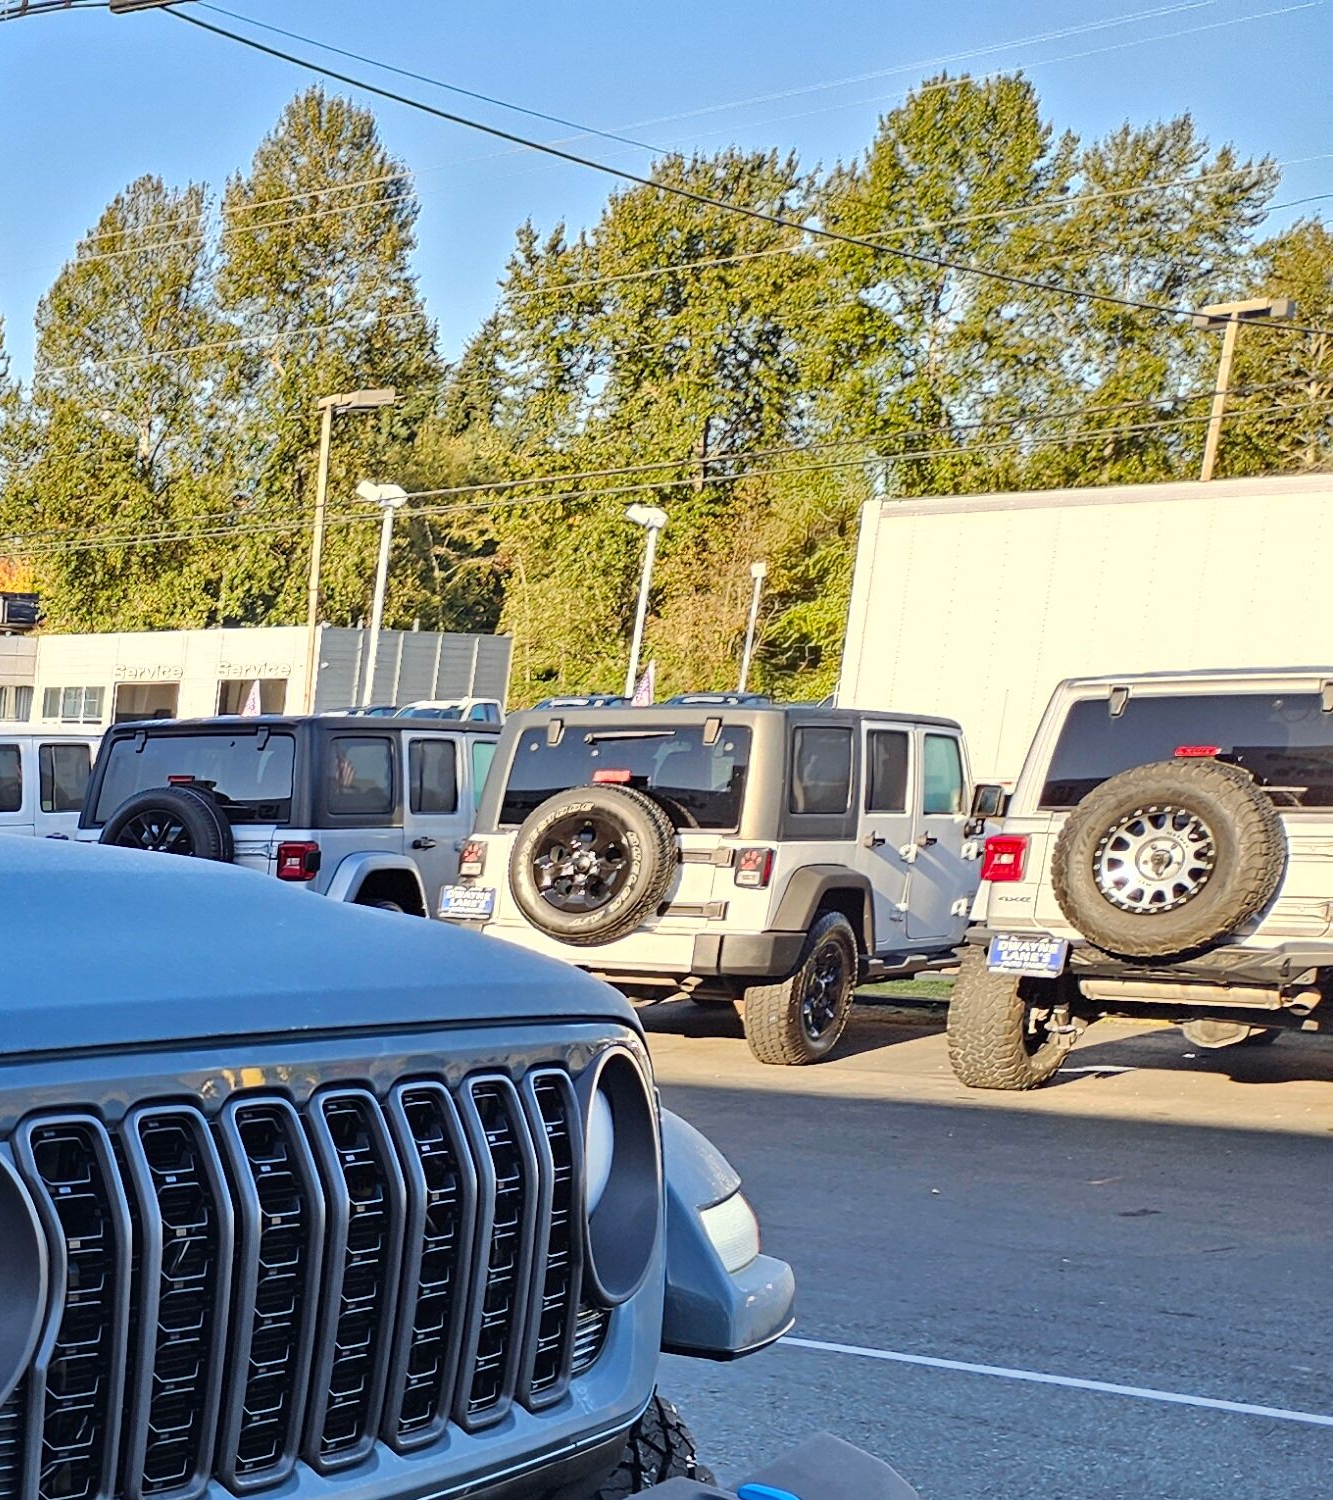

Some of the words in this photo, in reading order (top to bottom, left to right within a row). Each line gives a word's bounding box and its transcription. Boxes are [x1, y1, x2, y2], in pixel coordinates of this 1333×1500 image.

[115, 663, 183, 679] Service
[218, 660, 291, 676] Service
[997, 941, 1059, 954] DWAYNE
[1001, 951, 1051, 963] LANE'S
